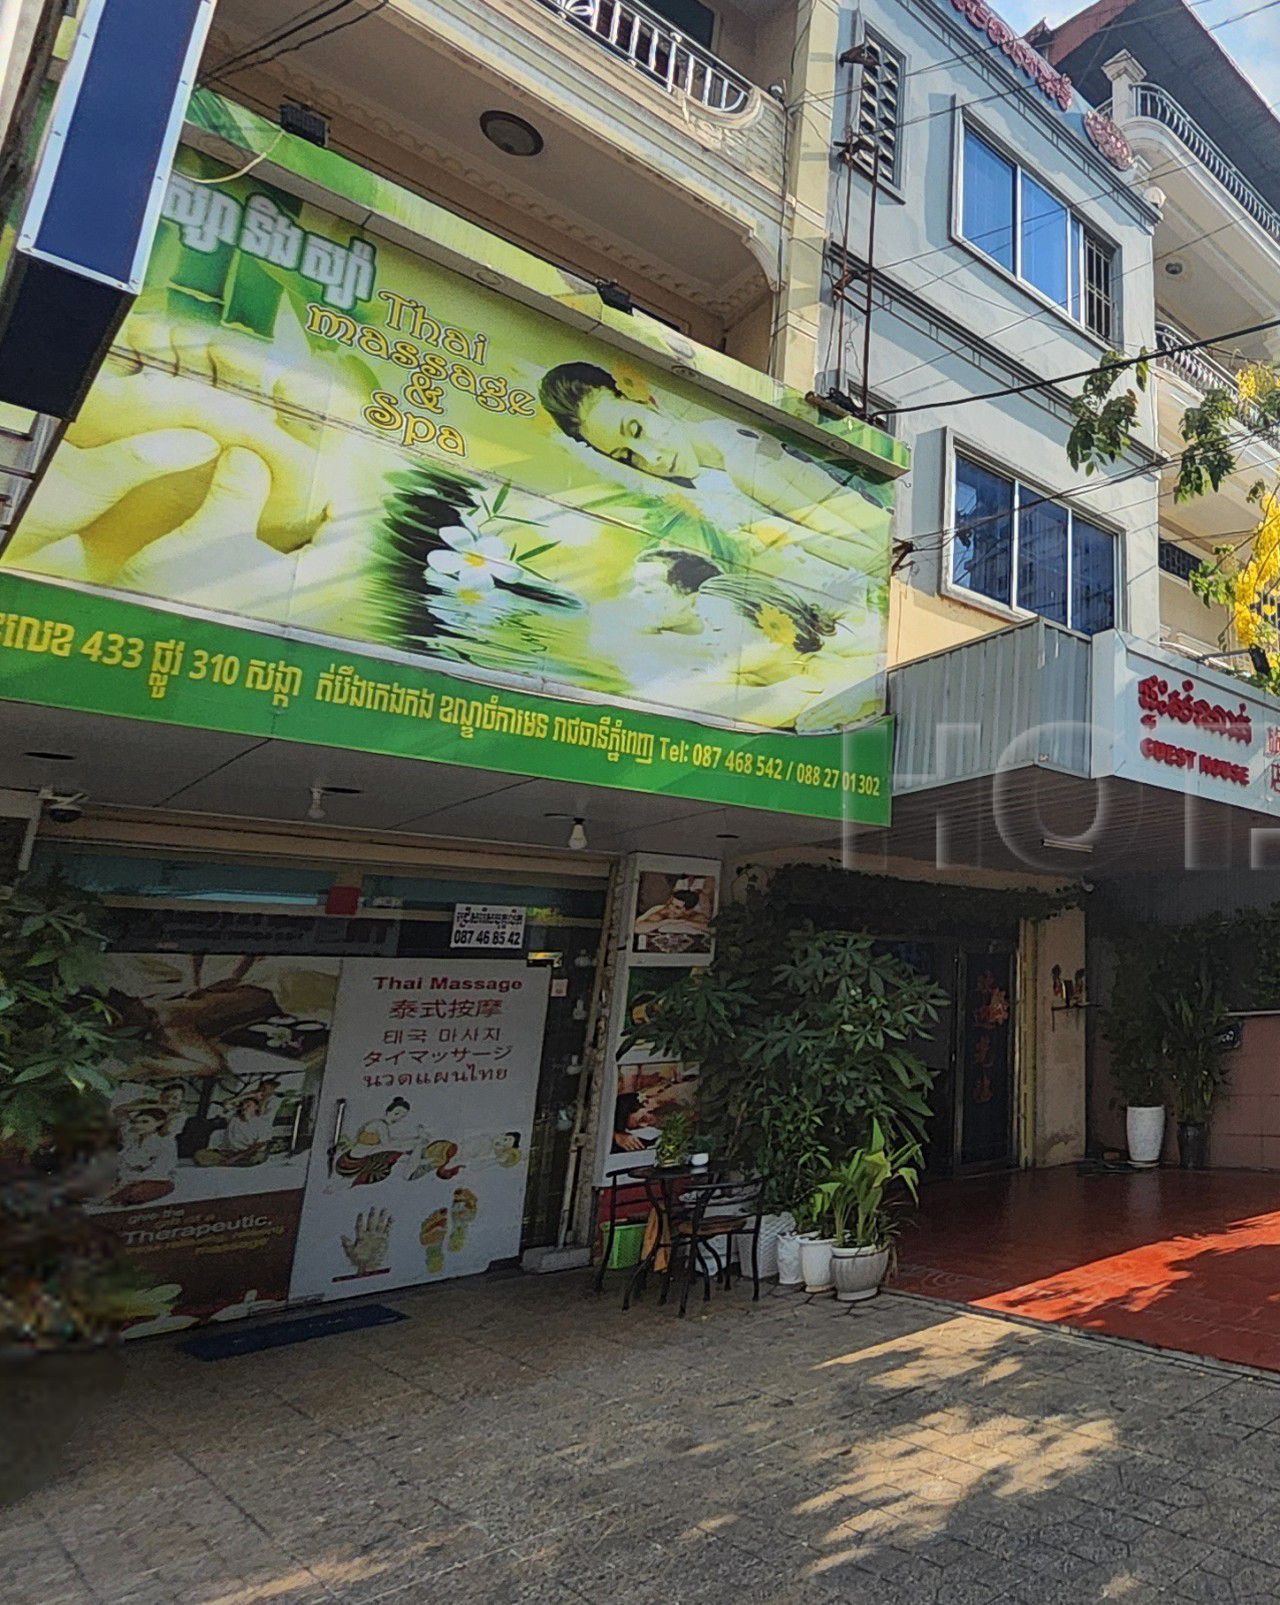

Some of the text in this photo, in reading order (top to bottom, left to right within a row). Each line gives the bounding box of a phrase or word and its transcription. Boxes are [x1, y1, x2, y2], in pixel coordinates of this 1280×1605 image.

[378, 291, 487, 365] Thai
[306, 304, 538, 417] massage
[404, 370, 445, 414] &
[363, 389, 468, 458] Spa
[80, 630, 145, 669] 433
[189, 649, 240, 686] 310
[659, 736, 689, 763] Tel:
[692, 742, 722, 769] 087
[724, 749, 753, 775] 468
[755, 755, 783, 781] 542
[796, 763, 821, 786] 088
[823, 768, 840, 789] 27
[1139, 736, 1251, 787] GUEST HOUSE
[453, 929, 522, 946] 087 46 85 42
[373, 976, 523, 993] Thai Massage
[388, 999, 503, 1020] 泰式按摩
[383, 1027, 501, 1045] 태국 마사지
[362, 1045, 514, 1068] タイマッサージ
[362, 1063, 508, 1088] นวดแผนไทย
[121, 1214, 272, 1246] Therapeutic.
